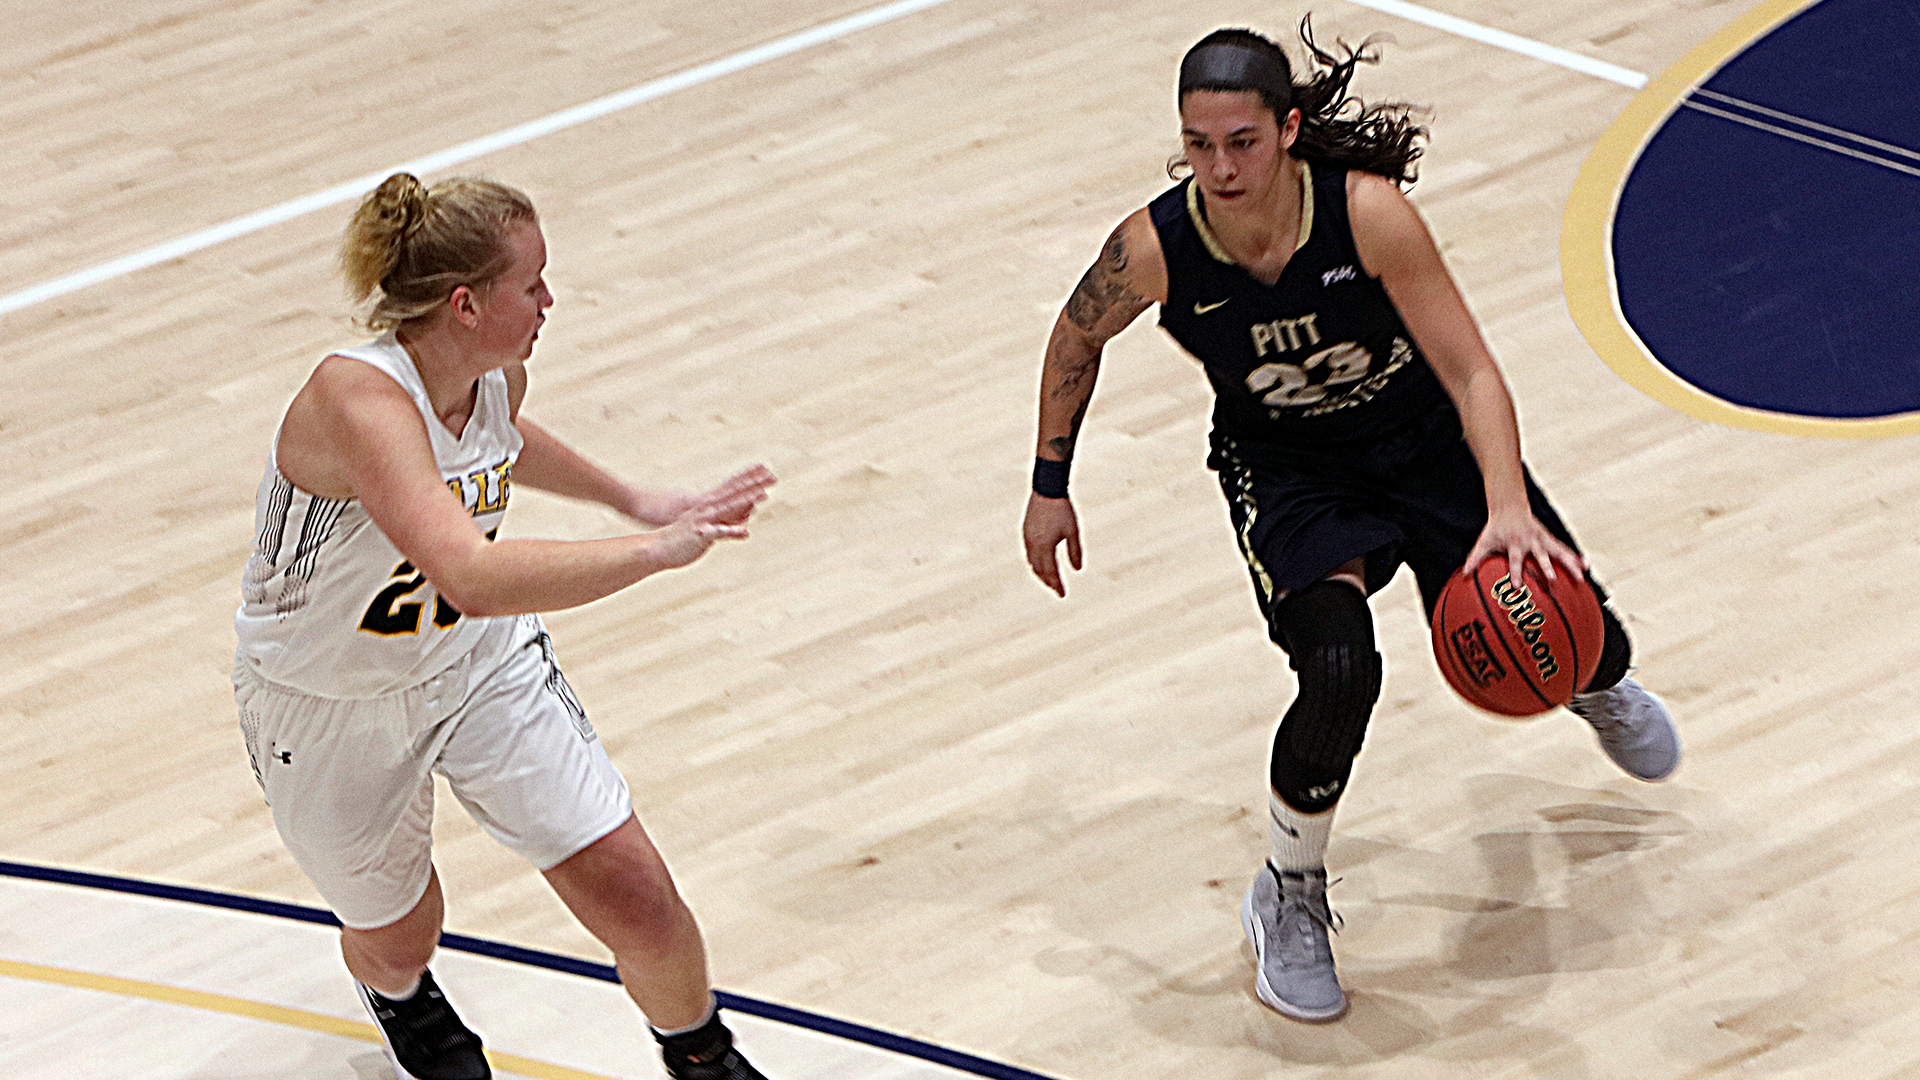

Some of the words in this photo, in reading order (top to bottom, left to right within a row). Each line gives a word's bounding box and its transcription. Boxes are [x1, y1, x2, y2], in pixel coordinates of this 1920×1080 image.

[1251, 312, 1322, 358] PITT
[1456, 621, 1505, 688] PSAC
[1491, 573, 1559, 683] Wilson
